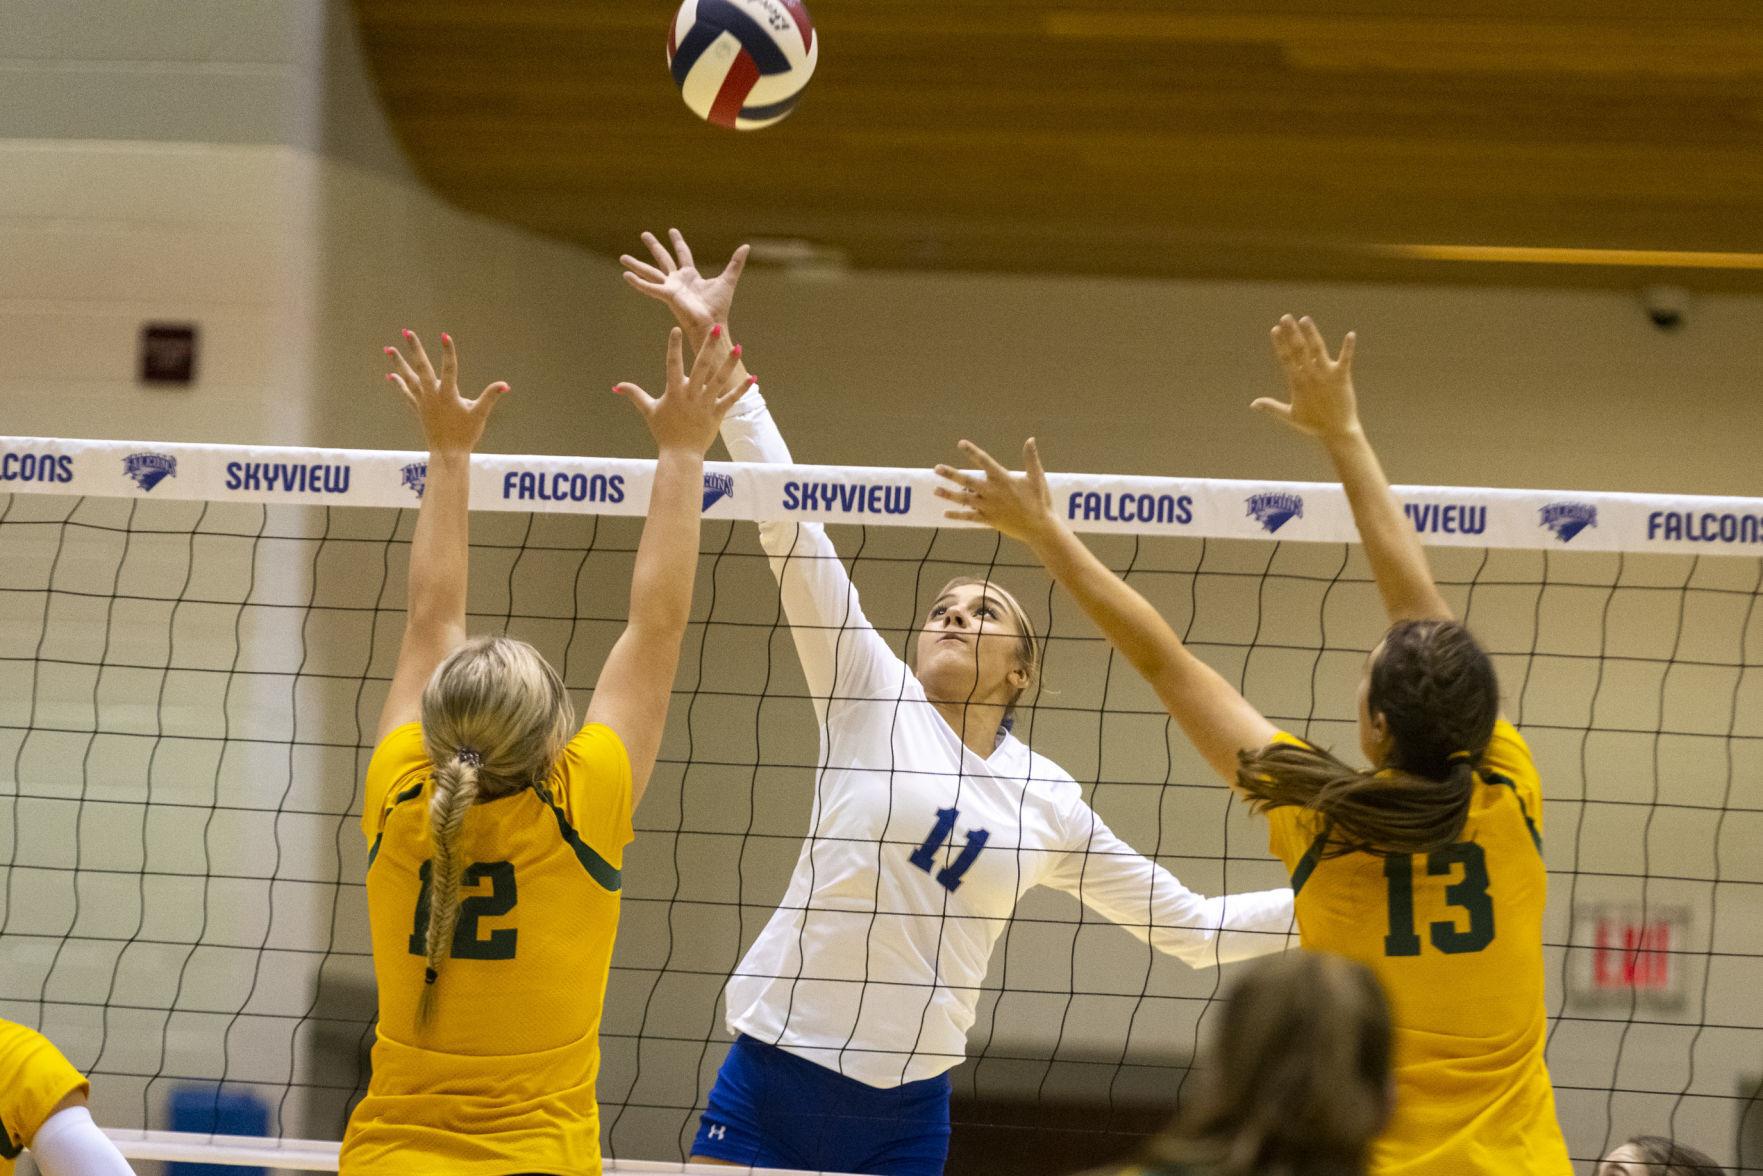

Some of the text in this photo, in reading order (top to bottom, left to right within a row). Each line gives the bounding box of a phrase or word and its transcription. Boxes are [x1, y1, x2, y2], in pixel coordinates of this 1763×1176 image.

[0, 452, 73, 483] CONS
[226, 462, 351, 493] SKYVIEW
[503, 471, 625, 504] FALCONS
[783, 481, 911, 514] SKYVIEW
[1068, 491, 1193, 524] FALCONS
[1647, 511, 1763, 542] FALCON
[909, 806, 990, 892] 11
[1384, 840, 1495, 957] 13
